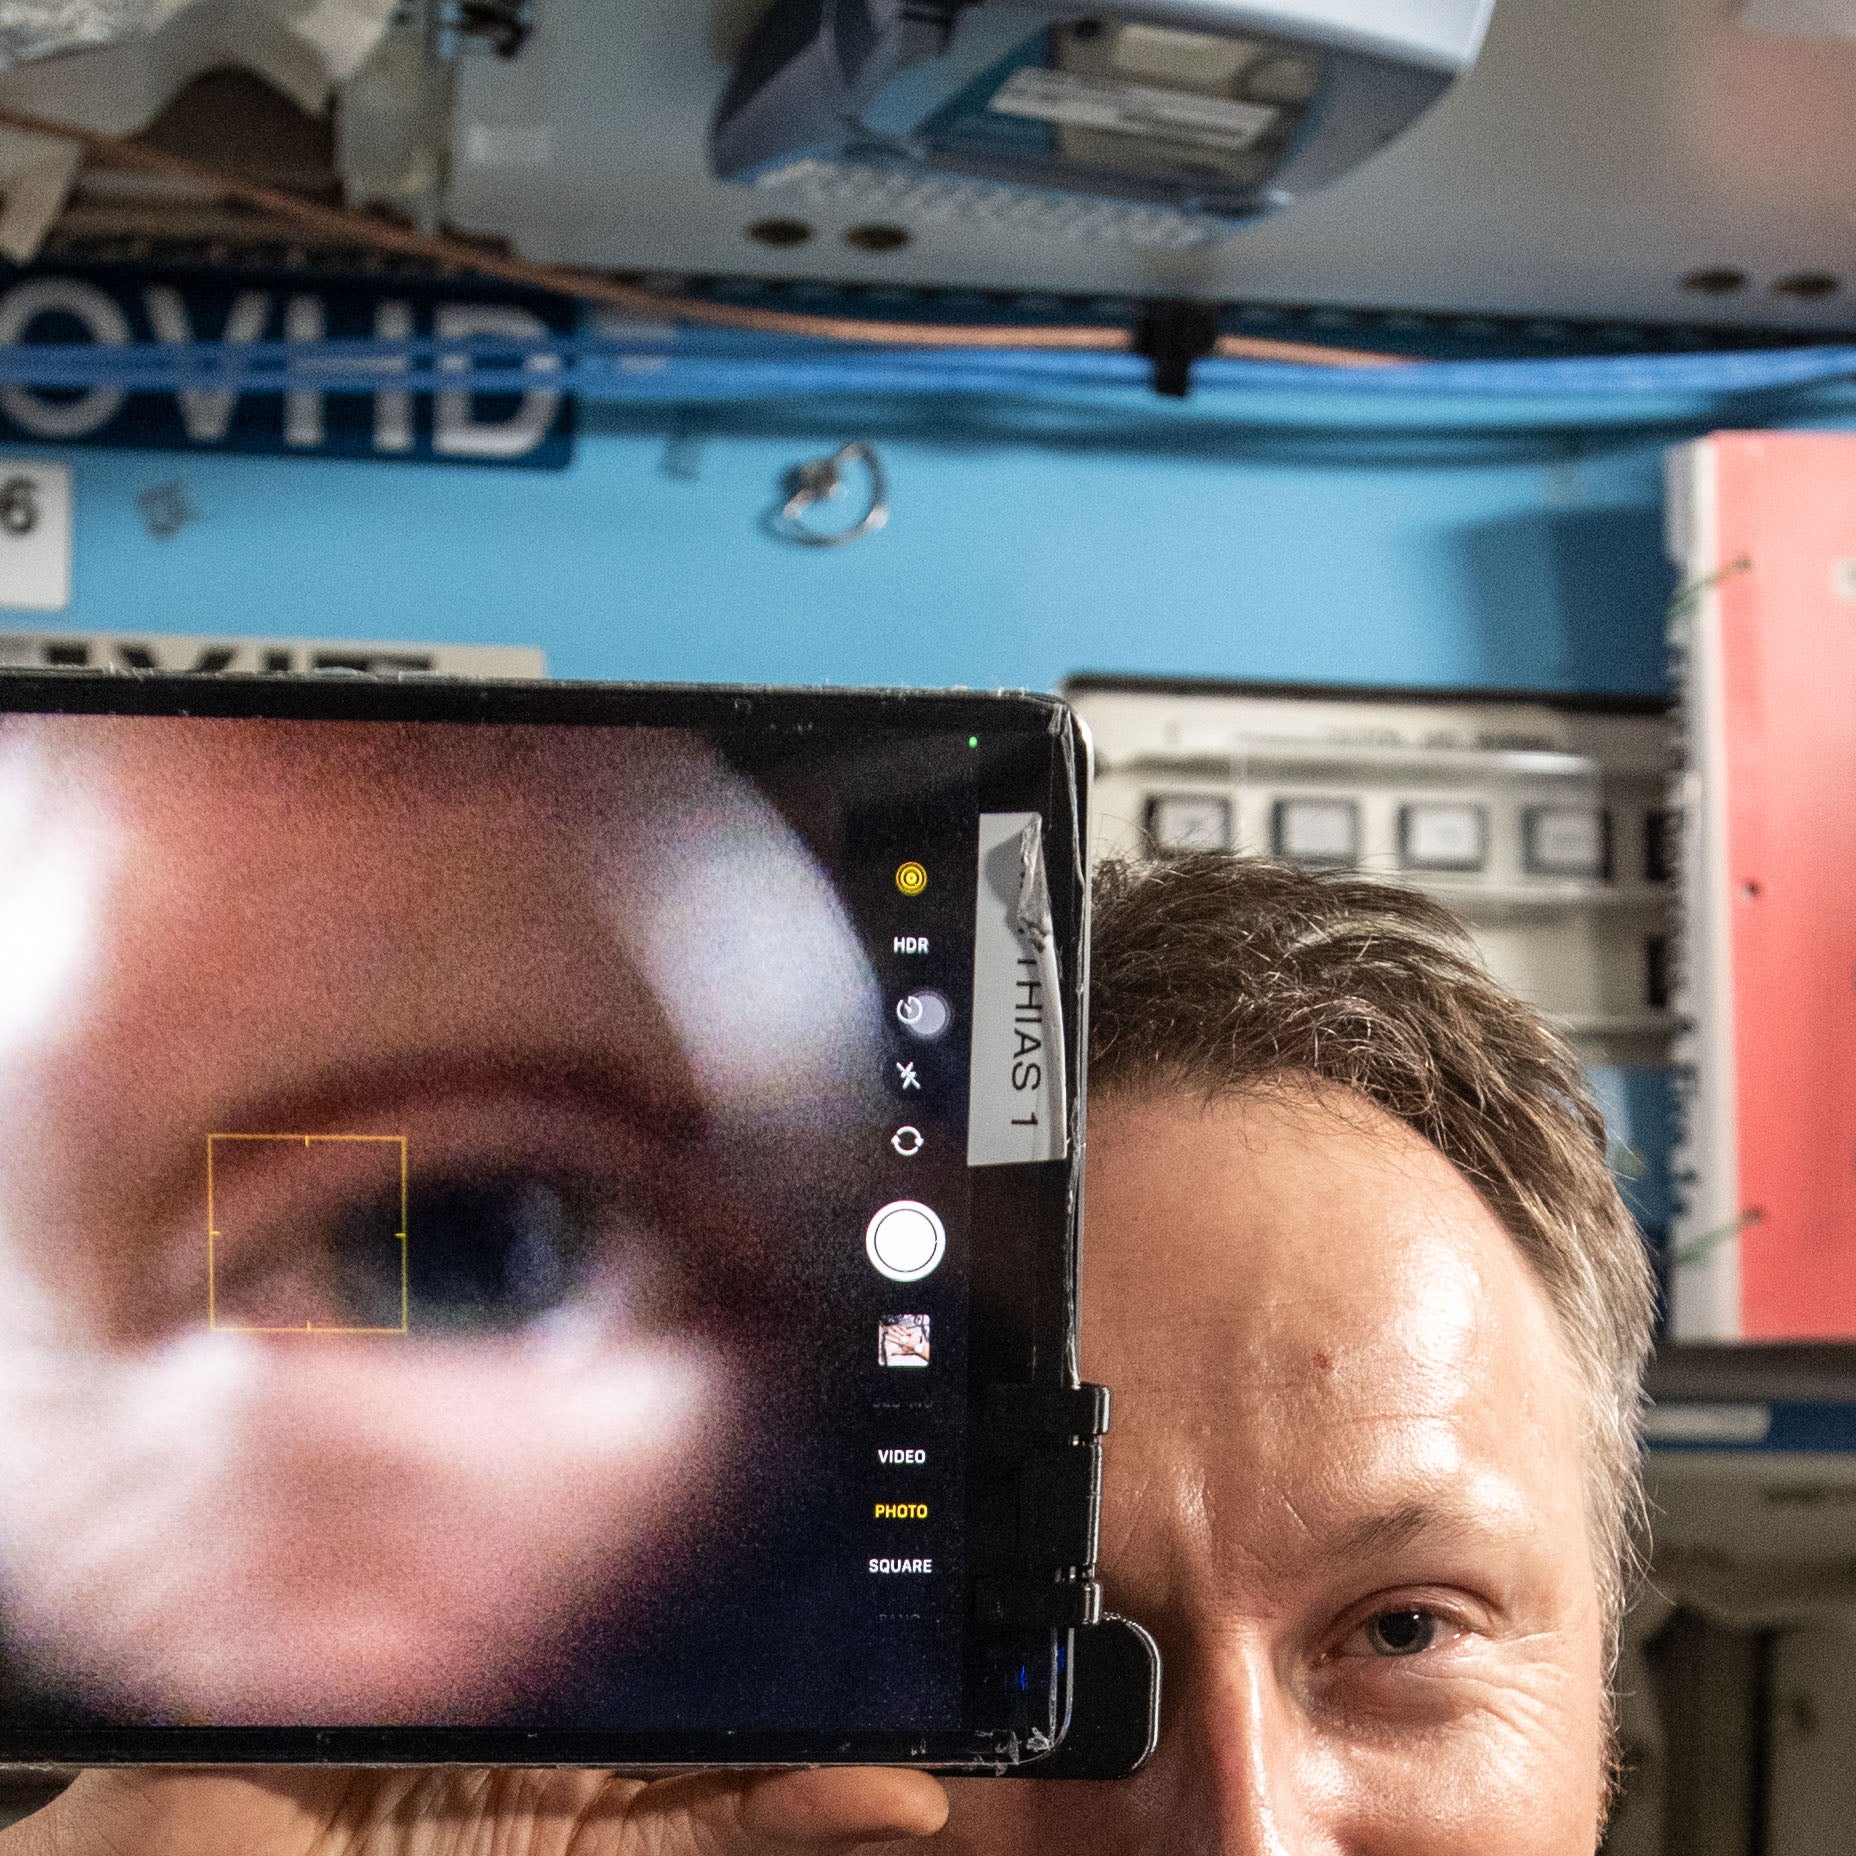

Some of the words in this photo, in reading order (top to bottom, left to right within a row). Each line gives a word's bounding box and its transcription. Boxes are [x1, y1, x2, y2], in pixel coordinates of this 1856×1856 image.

[893, 936, 930, 954] HDR
[877, 1449, 927, 1465] VIDEO
[874, 1503, 929, 1519] PHOTO
[868, 1558, 933, 1574] SQUARE
